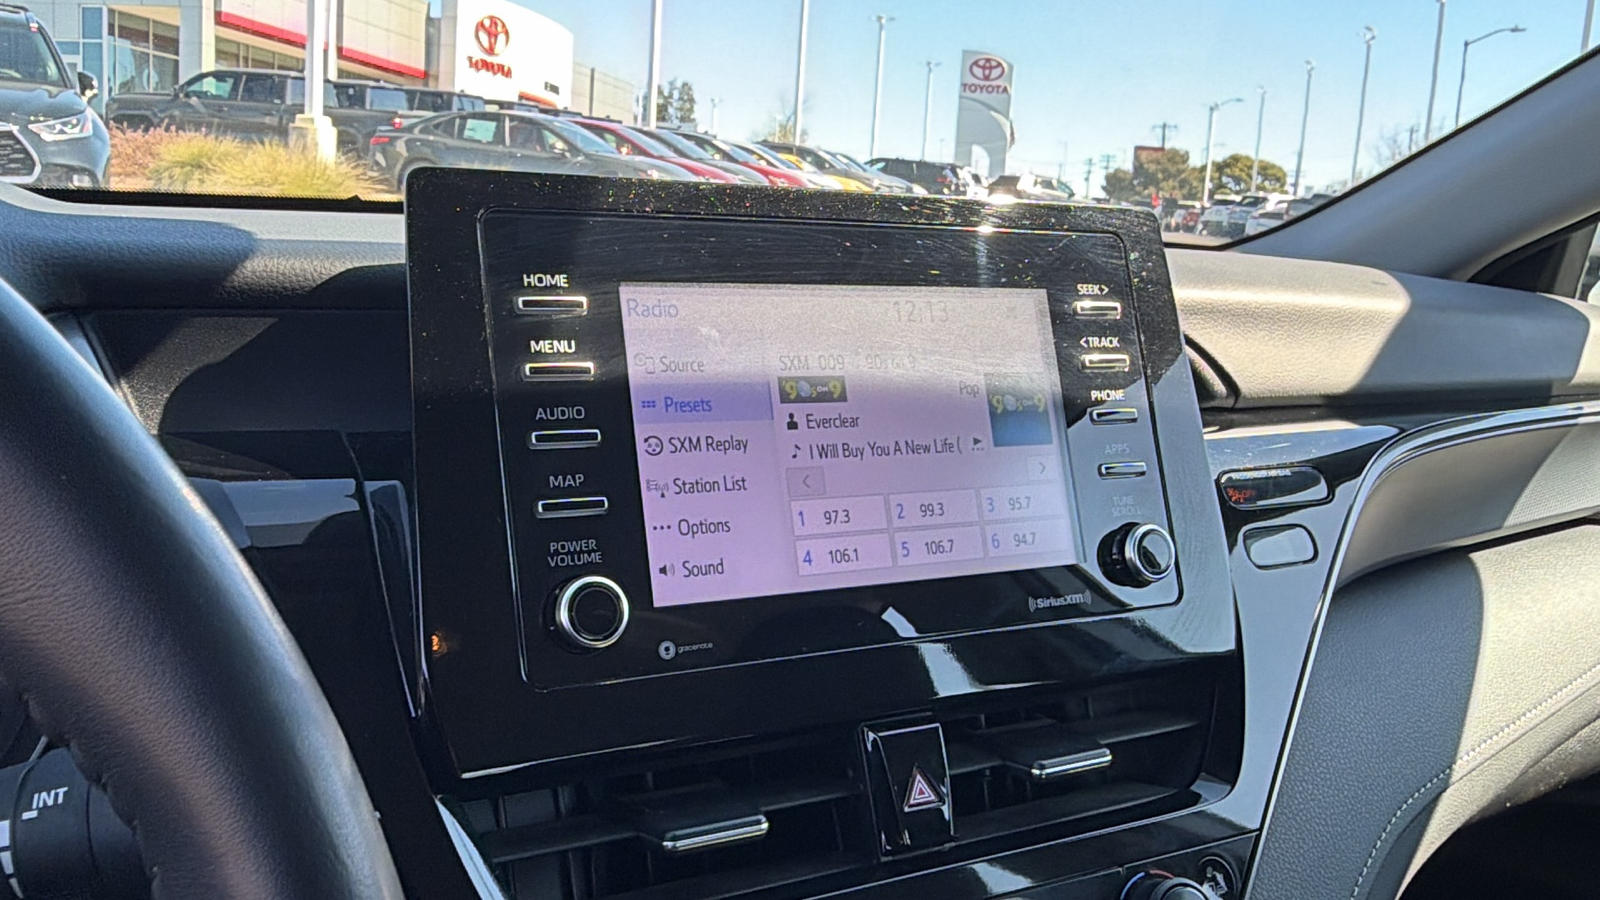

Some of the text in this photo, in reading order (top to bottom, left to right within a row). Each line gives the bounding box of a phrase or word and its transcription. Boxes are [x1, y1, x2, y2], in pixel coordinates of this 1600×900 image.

[467, 55, 512, 79] TOYOTA
[961, 83, 1009, 94] TOYOTA
[523, 273, 569, 287] HOME
[1077, 283, 1101, 295] SEEK
[626, 299, 679, 318] Radio
[530, 340, 576, 353] MENU
[1088, 337, 1120, 348] TRACK
[660, 356, 705, 373] Source
[779, 354, 810, 371] SXM
[818, 354, 846, 370] 009
[959, 382, 980, 396] Pop
[1091, 390, 1126, 401] PHONE
[535, 406, 586, 421] AUDIO
[664, 397, 713, 413] Presets
[806, 413, 861, 430] Everclear
[668, 435, 749, 455] SXM Replay
[817, 443, 840, 459] Will
[842, 442, 865, 461] Buy
[867, 441, 891, 457] You
[893, 440, 904, 456] A
[905, 438, 932, 455] New
[934, 438, 956, 454] Life
[1104, 444, 1130, 455] APPS
[549, 474, 585, 488] MAP
[672, 475, 748, 495] Station List
[896, 502, 945, 519] 2 99.3
[987, 496, 1032, 513] 3 95.7
[798, 509, 851, 527] 1 97.3
[677, 518, 731, 539] Options
[550, 540, 597, 553] POWER
[901, 539, 955, 557] 5 106.7
[991, 532, 1037, 549] 6 94.7
[547, 552, 603, 567] VOLUME
[802, 548, 860, 566] 4 106.1
[682, 558, 725, 578] Sound
[32, 787, 69, 809] INT
